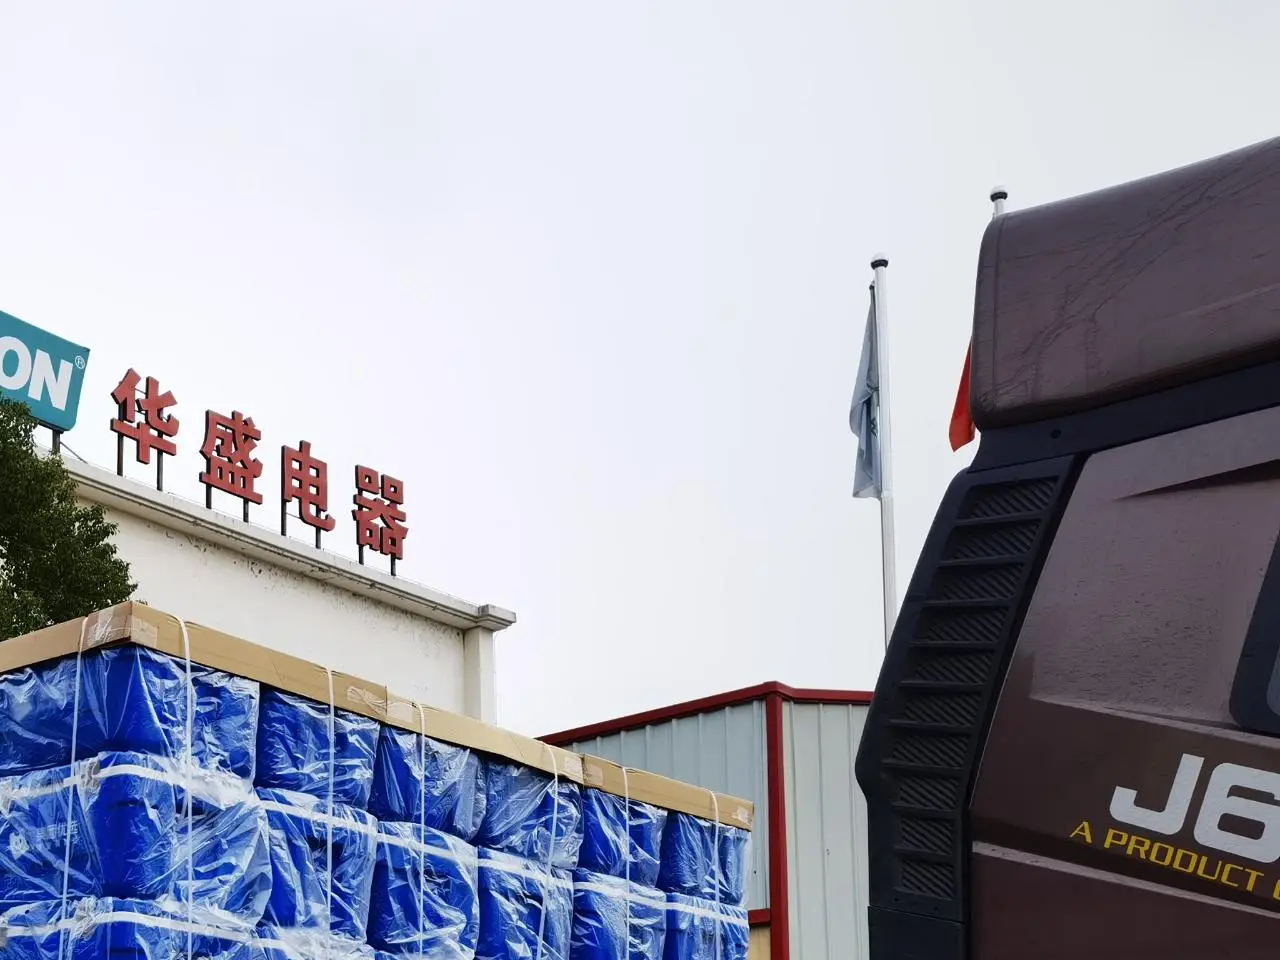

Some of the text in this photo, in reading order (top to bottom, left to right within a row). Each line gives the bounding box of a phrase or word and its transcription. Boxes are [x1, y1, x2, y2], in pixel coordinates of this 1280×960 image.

[110, 367, 409, 560] 华盛电器
[1070, 821, 1093, 844] A
[1103, 828, 1265, 892] PRODUCT
[1109, 753, 1280, 864] J6
